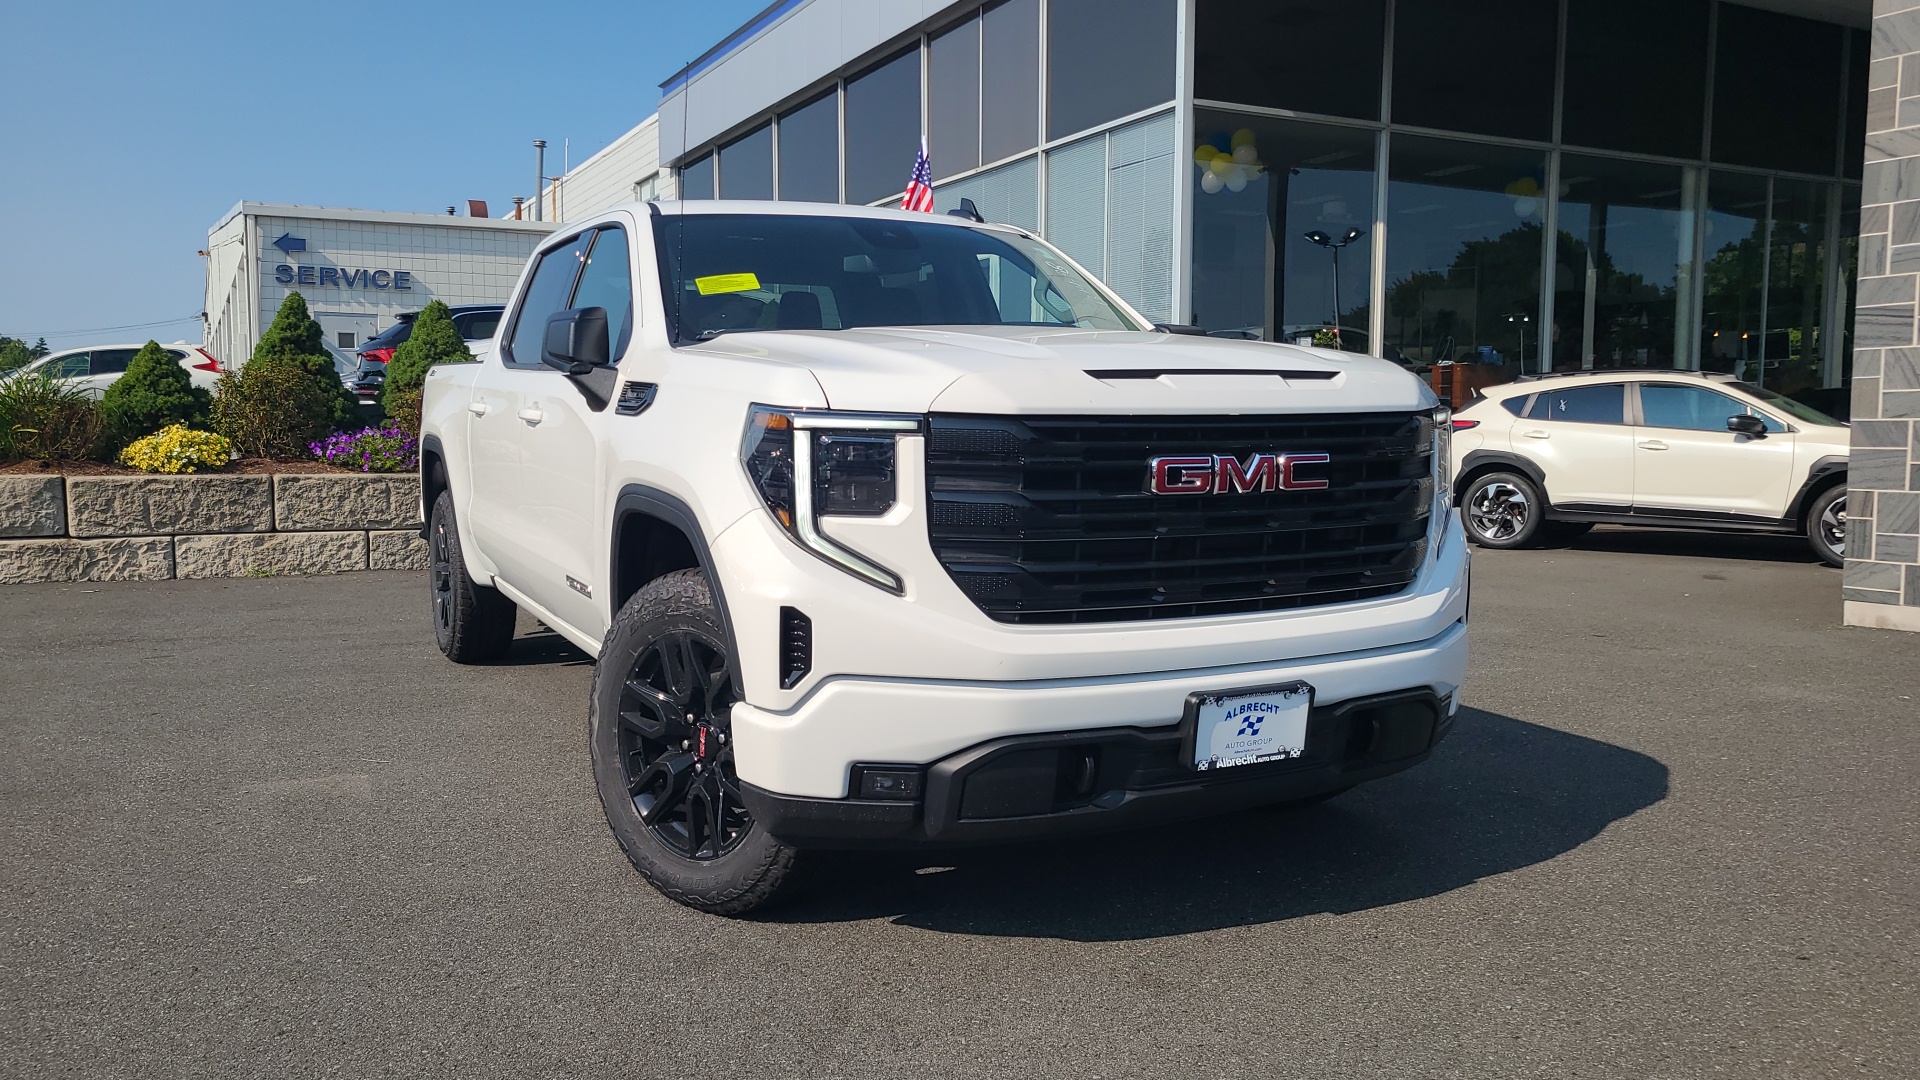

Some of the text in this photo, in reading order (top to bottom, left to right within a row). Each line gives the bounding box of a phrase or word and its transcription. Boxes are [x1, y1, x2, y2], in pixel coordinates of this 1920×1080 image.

[275, 264, 411, 290] SERVICE
[1151, 453, 1330, 495] GMC
[1225, 702, 1280, 722] ALBRECHT
[1225, 737, 1273, 750] AUTO GROUP
[1216, 753, 1257, 768] Albrecht
